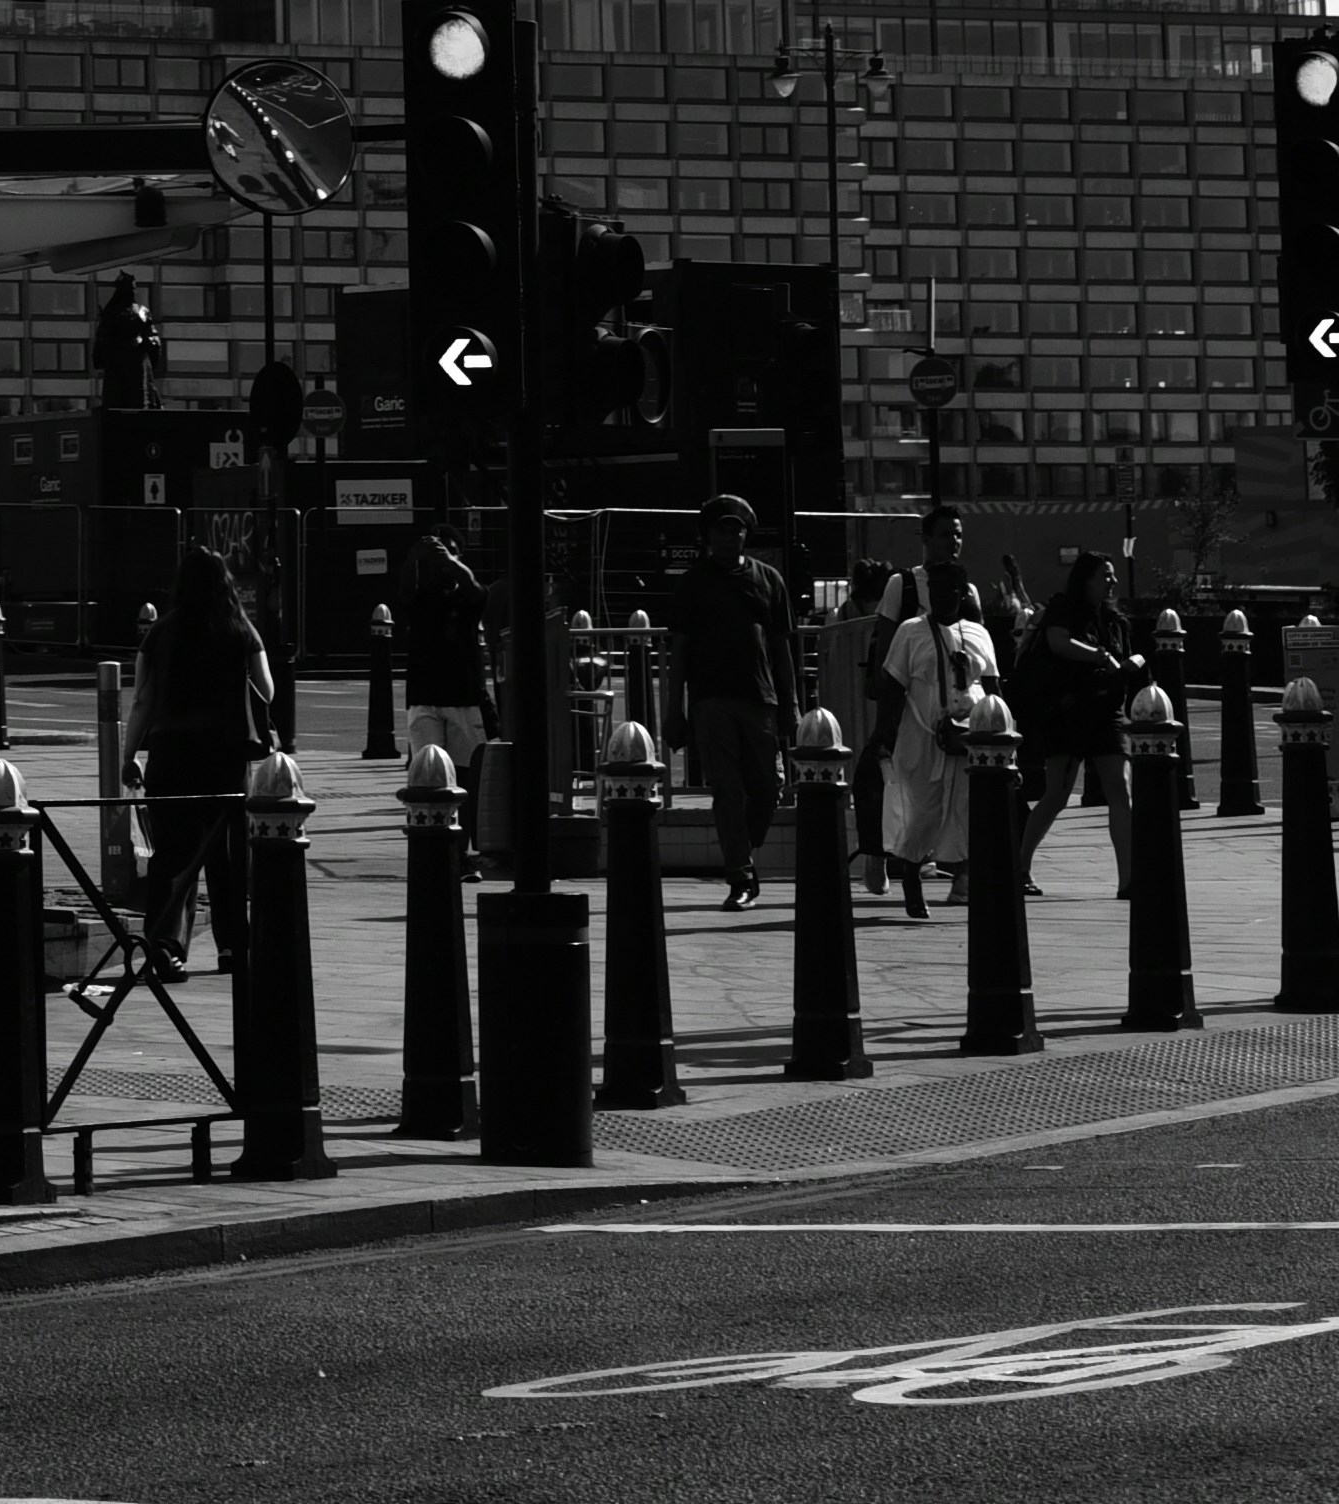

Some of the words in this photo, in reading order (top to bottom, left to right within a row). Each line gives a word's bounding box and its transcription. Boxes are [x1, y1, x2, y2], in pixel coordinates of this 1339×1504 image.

[374, 395, 406, 412] Garic
[39, 475, 62, 493] Garic
[353, 493, 407, 506] TAZIKER
